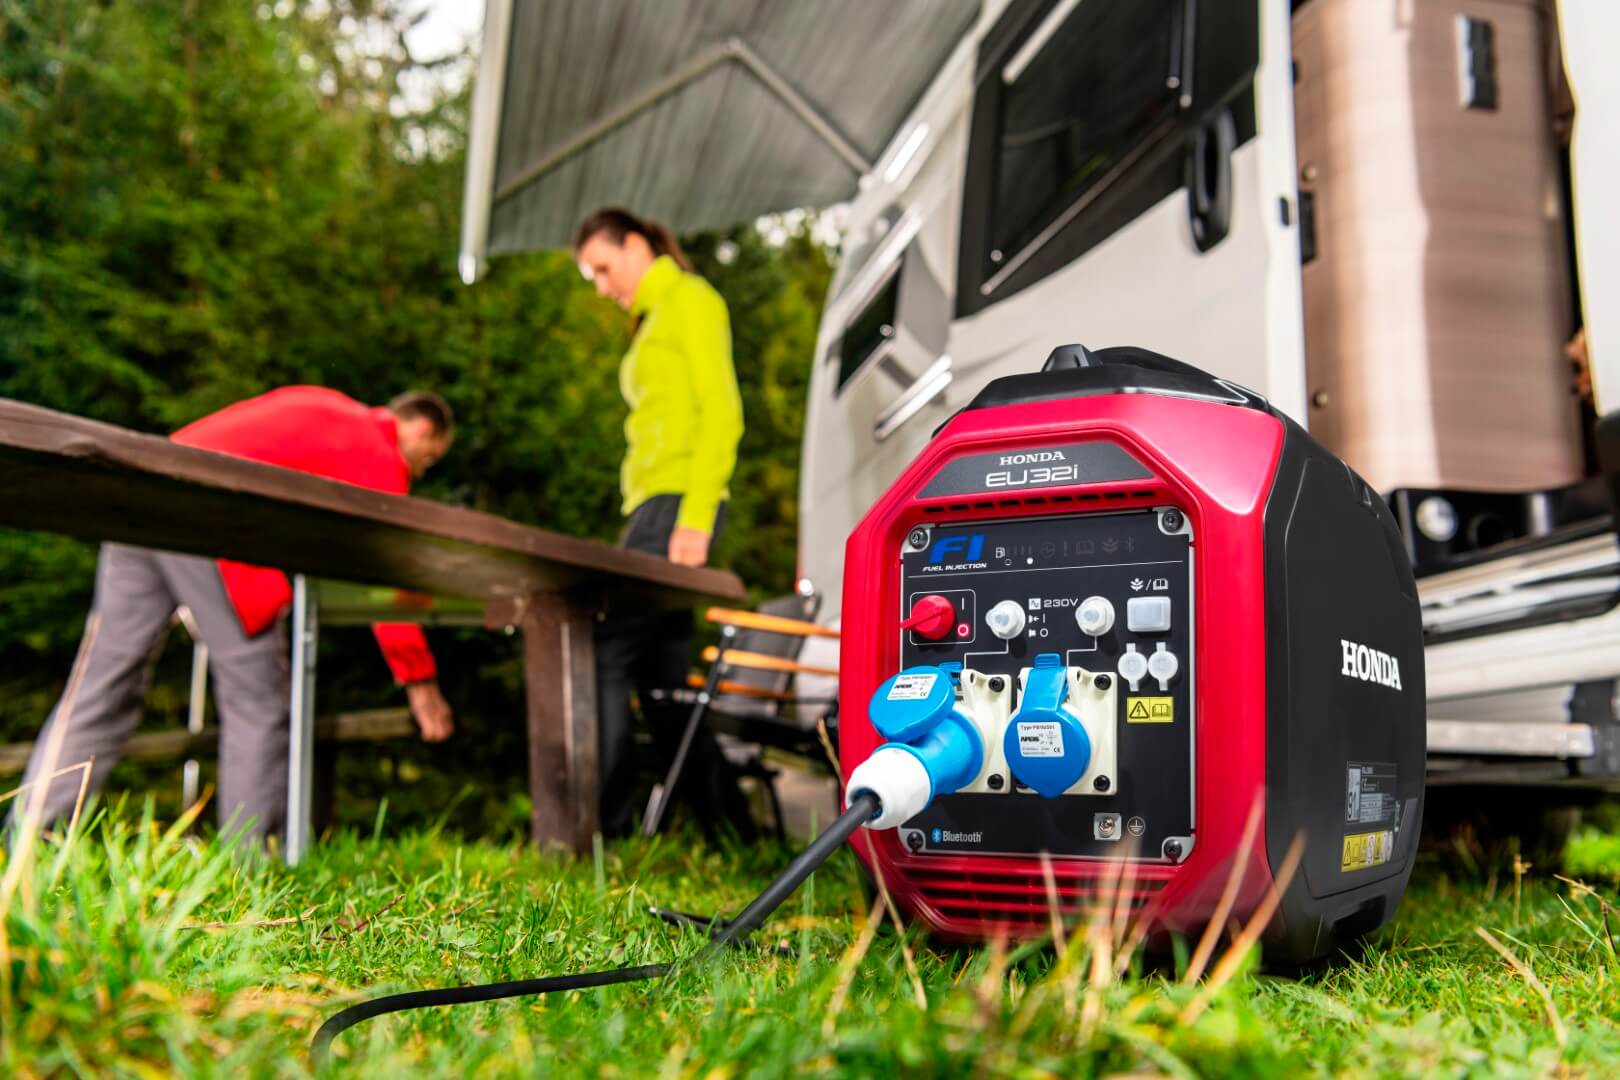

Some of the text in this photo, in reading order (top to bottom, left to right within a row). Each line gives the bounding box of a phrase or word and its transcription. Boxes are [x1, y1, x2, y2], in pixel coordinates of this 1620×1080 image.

[1000, 451, 1065, 465] HONDA
[986, 464, 1078, 487] EU32i
[928, 533, 985, 564] FI
[923, 562, 987, 572] FUEL INJECTION
[1043, 598, 1079, 608] 230V
[1340, 639, 1402, 691] HONDA
[942, 830, 981, 843] Bluetooth
